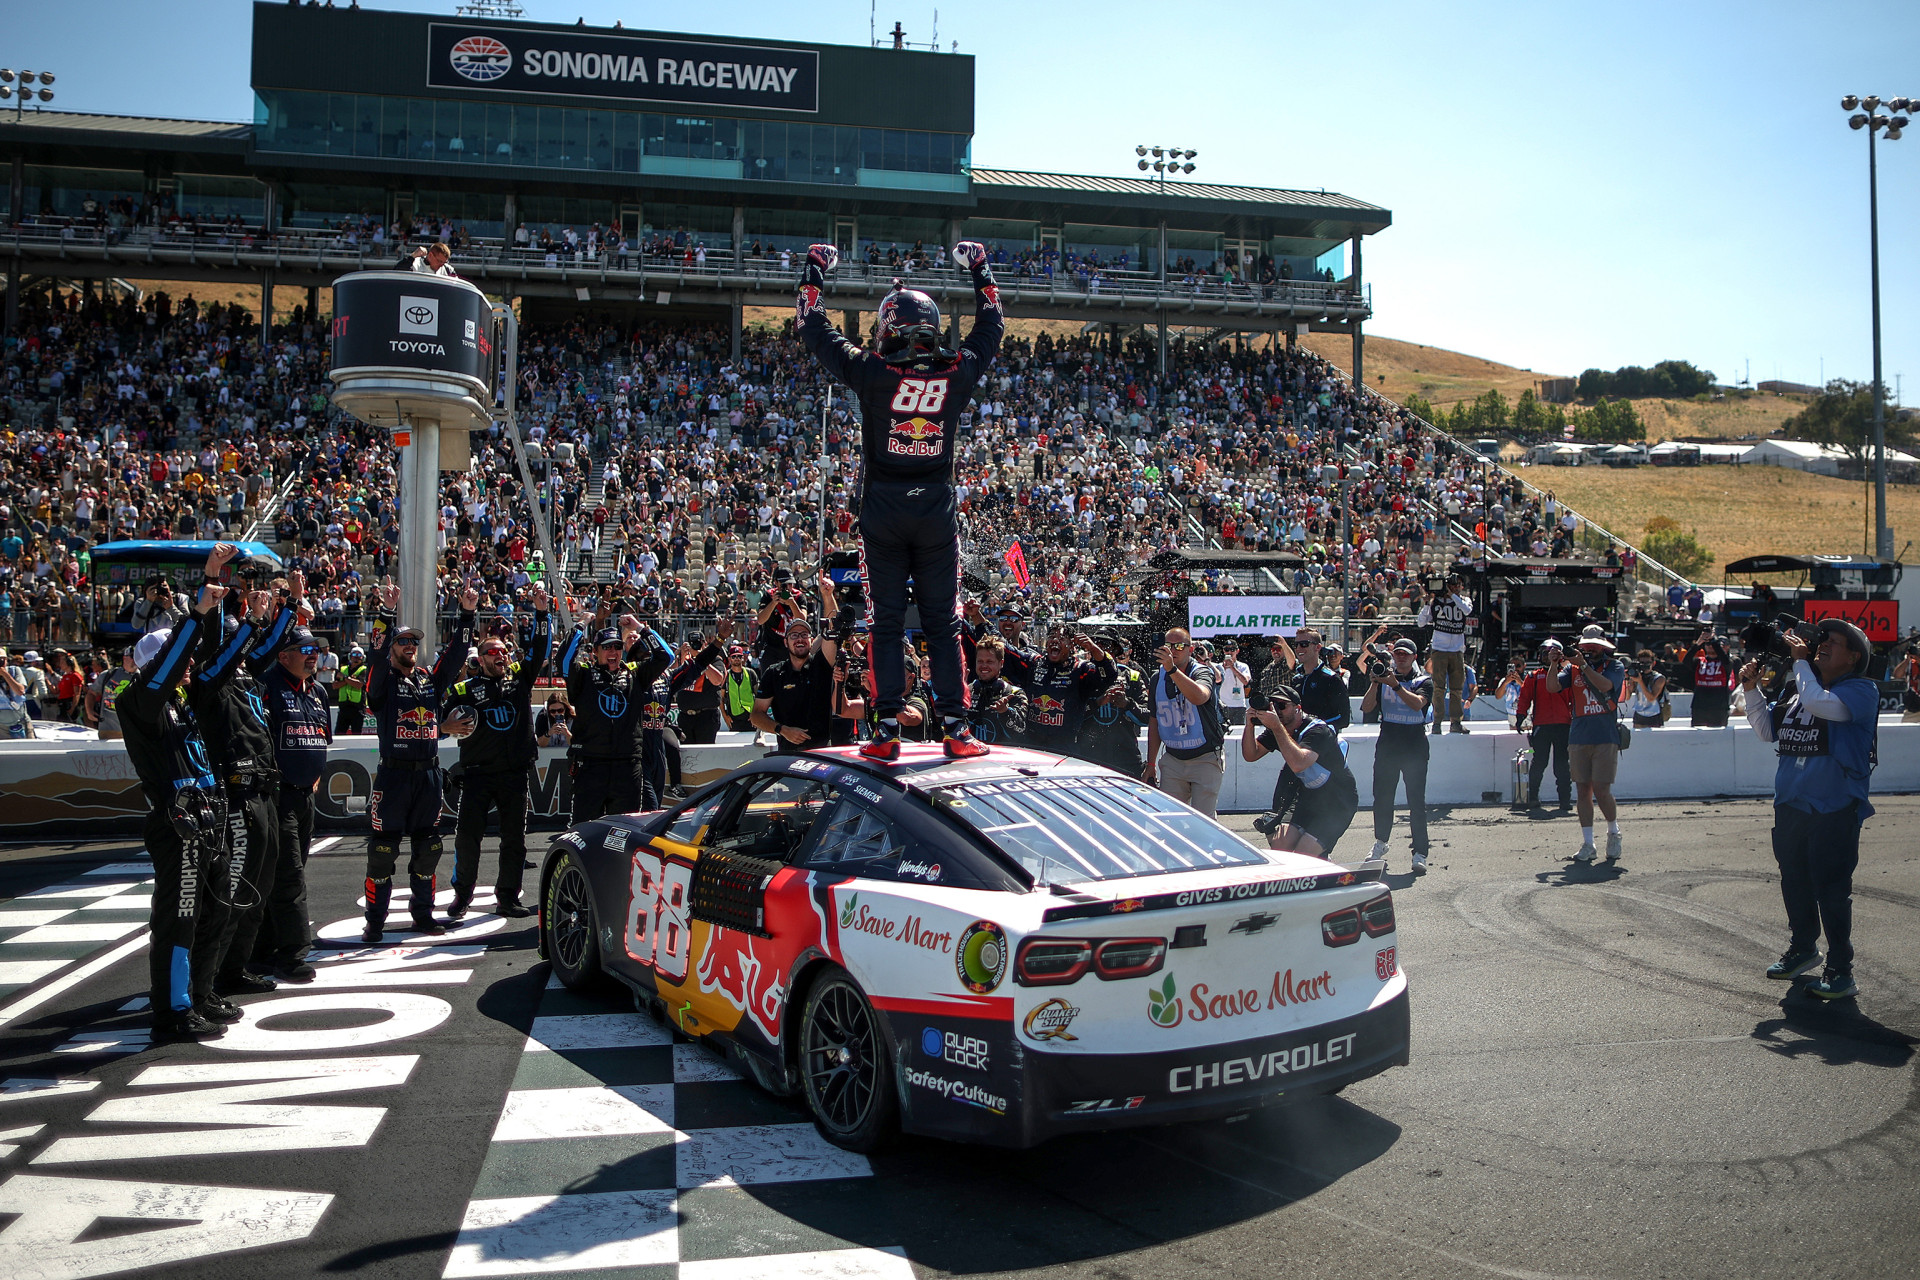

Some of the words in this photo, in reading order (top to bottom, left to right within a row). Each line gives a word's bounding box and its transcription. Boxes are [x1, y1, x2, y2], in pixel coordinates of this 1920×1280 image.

[523, 48, 649, 84] SONOMA
[656, 58, 798, 93] RACEWAY
[388, 340, 446, 356] TOYOTA
[461, 339, 477, 350] TOYOTA
[891, 379, 948, 412] 88
[888, 437, 917, 456] Red
[917, 439, 943, 456] Bull
[1192, 614, 1260, 628] DOLLAR
[1260, 614, 1302, 628] TREE
[1434, 605, 1463, 621] 206
[1811, 610, 1890, 632] Kbota
[1043, 713, 1064, 727] Bull
[1584, 703, 1608, 715] PHO
[286, 725, 302, 736] Red
[396, 725, 421, 739] Red
[642, 719, 654, 730] ed
[297, 737, 328, 746] TRACKHO
[853, 785, 882, 803] SIEMENS
[945, 784, 1001, 799] VAN
[1001, 777, 1130, 793] GISBERGEN
[371, 790, 383, 825] Red
[553, 854, 570, 879] YEAR
[897, 860, 928, 878] Wendy's
[177, 840, 199, 918] CKHOUSE
[1176, 888, 1223, 906] GIVES
[1228, 883, 1261, 899] YOU
[546, 886, 555, 931] GOOD
[625, 848, 692, 978] 88
[853, 904, 895, 938] Save
[895, 915, 952, 953] Mart
[957, 929, 972, 979] TRACKHOUSE
[992, 935, 1008, 986] TRACKHOUSE
[1374, 945, 1399, 982] 88
[1188, 983, 1262, 1022] Save
[1266, 968, 1336, 1010] Mart
[1037, 1007, 1080, 1020] QUAKER
[1041, 1016, 1072, 1027] STATE
[944, 1031, 988, 1056] QUAD
[944, 1050, 990, 1071] LOCK
[1169, 1032, 1357, 1093] CHEVROLET
[904, 1066, 1007, 1111] SafetyCulture
[1064, 1096, 1146, 1114] ZL1
